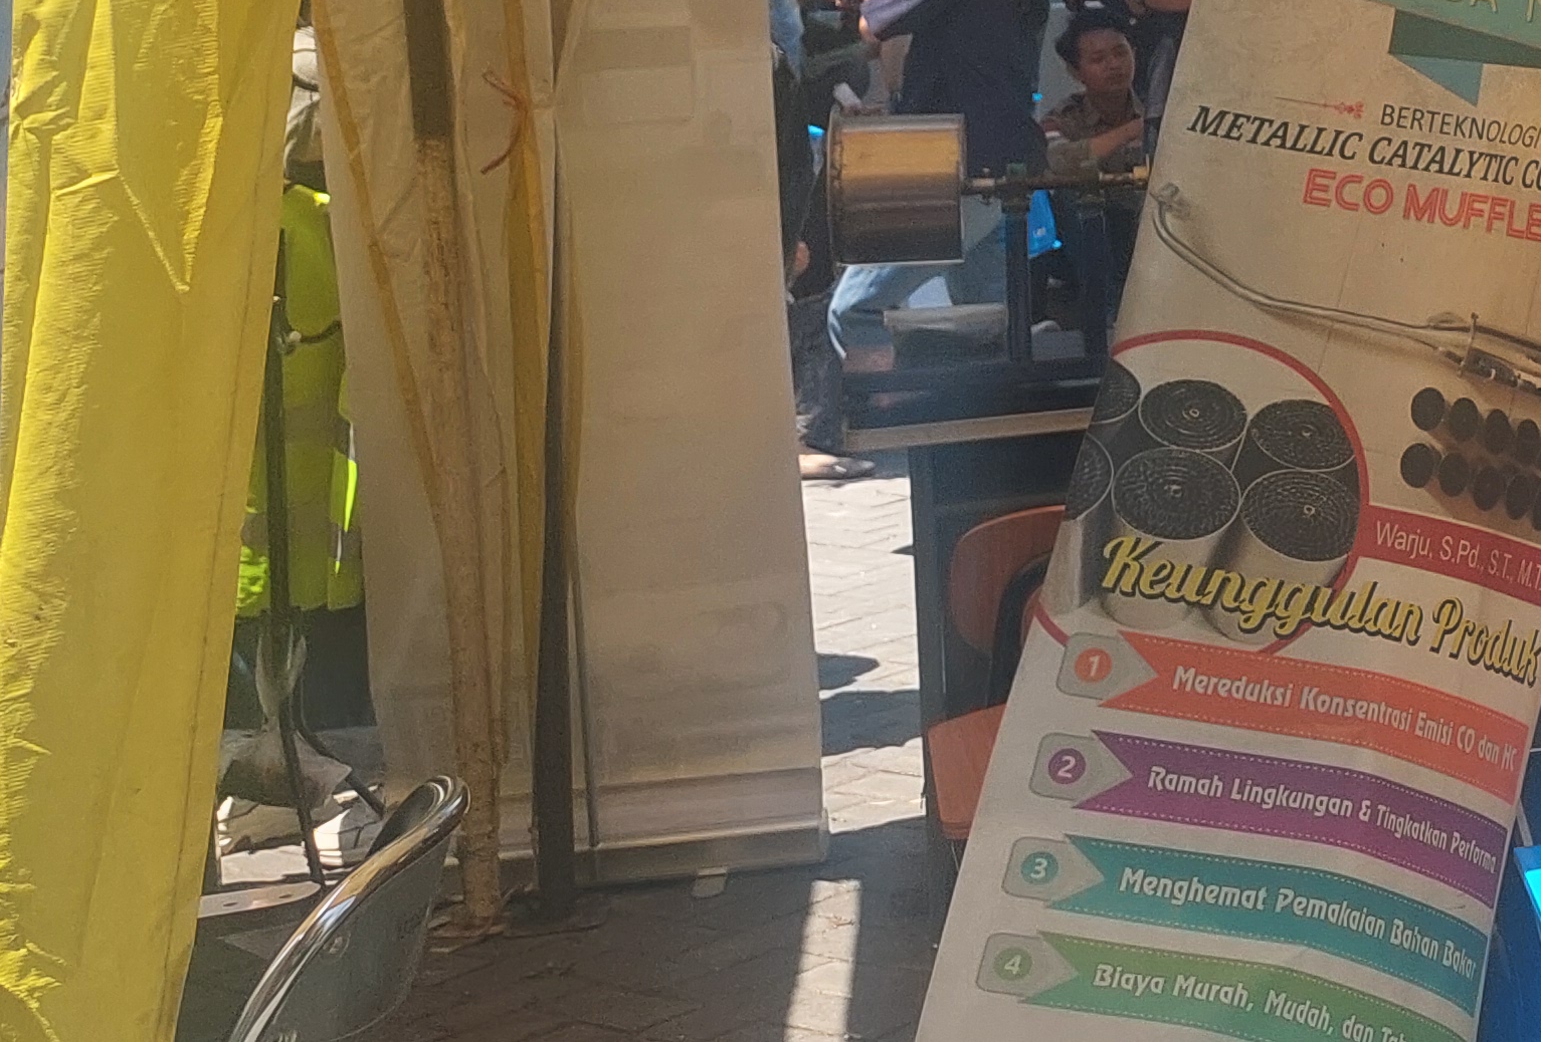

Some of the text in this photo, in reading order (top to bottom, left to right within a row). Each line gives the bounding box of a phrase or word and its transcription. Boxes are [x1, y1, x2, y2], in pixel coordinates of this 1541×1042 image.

[1186, 104, 1365, 162] METALLIC
[1367, 136, 1520, 187] CATALYTIC
[1302, 167, 1395, 216] ECO
[1101, 534, 1423, 647] Keunggulan
[1087, 654, 1101, 678] 1
[1172, 665, 1295, 709] Mereduksi
[1299, 685, 1415, 732] Konsentrasi
[1414, 710, 1454, 746] Emisi
[1456, 724, 1476, 755] CO
[1477, 734, 1499, 764] dan
[1056, 755, 1498, 875] 2 Ramah Lingkungan & Tingkatkan Performa
[1030, 858, 1477, 982] 3 Menghemat Pemakaian Bahan Bakar
[1003, 953, 1022, 976] 4
[1092, 963, 1166, 996] Biaya
[1172, 974, 1255, 1014] Murah,
[1263, 989, 1335, 1036] Mudah,
[1342, 1015, 1375, 1042] dan
